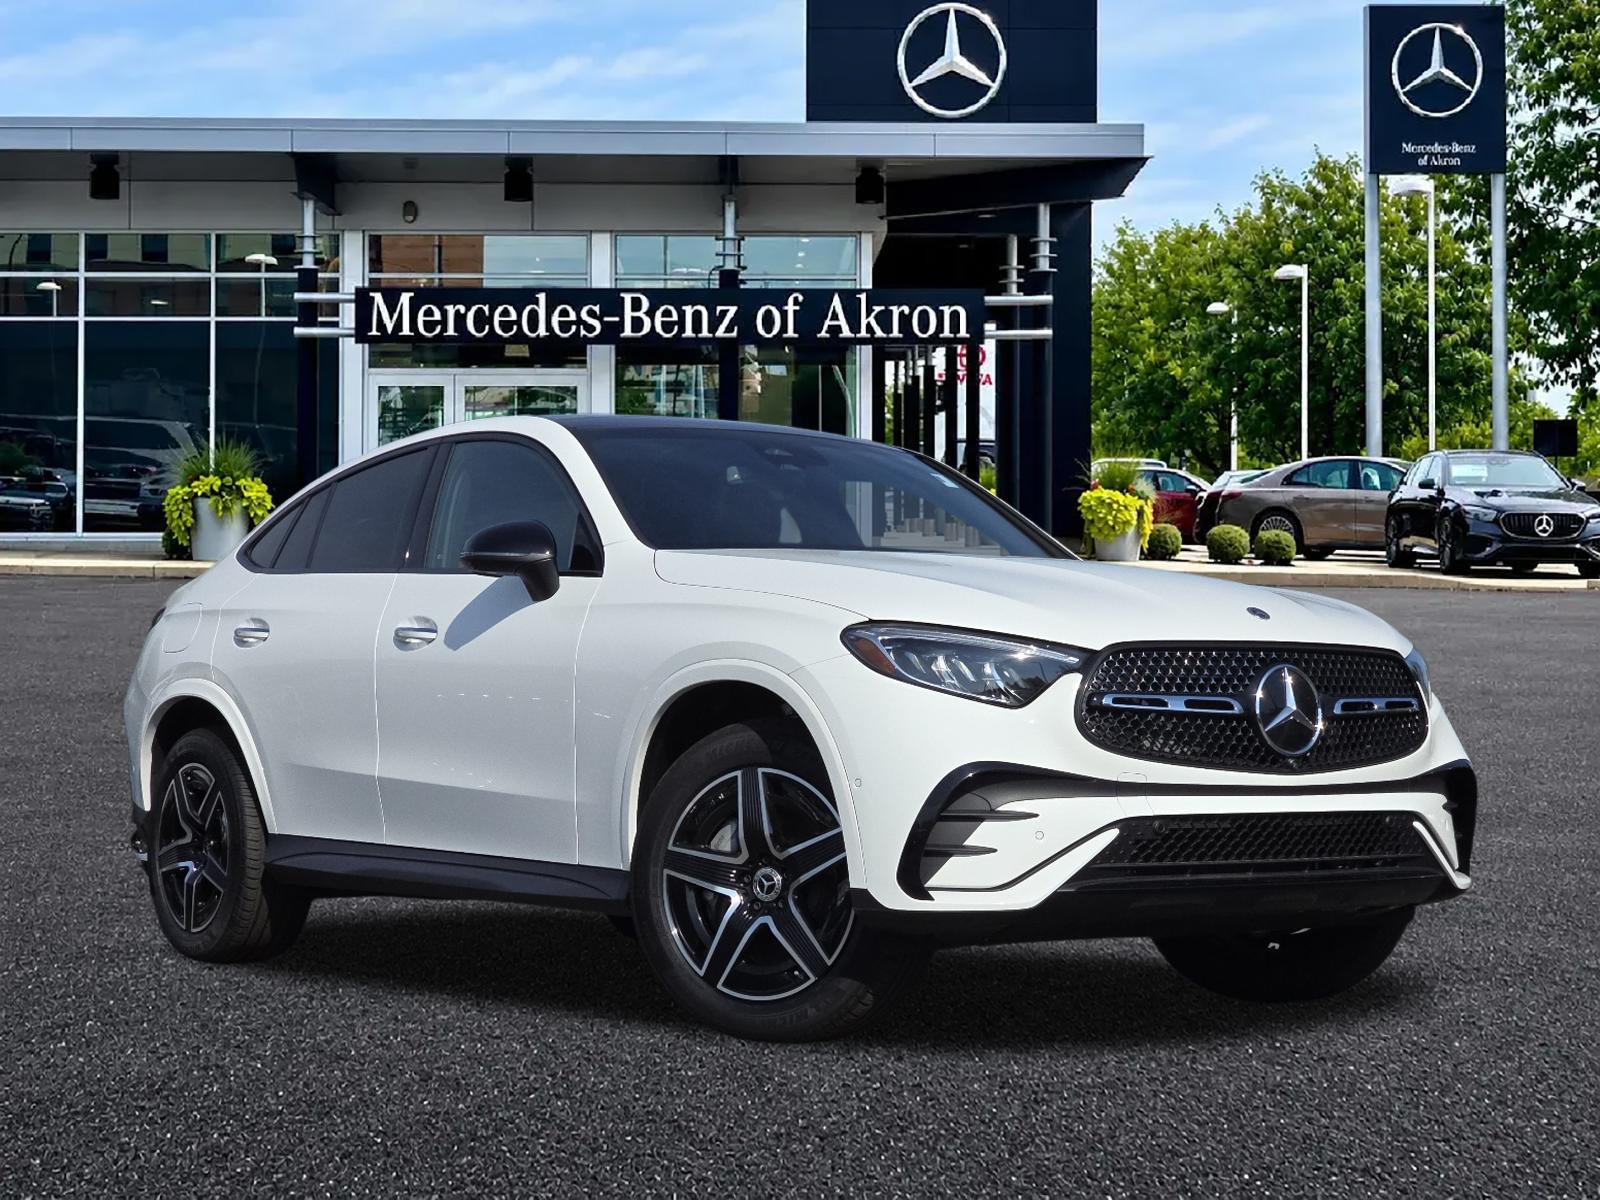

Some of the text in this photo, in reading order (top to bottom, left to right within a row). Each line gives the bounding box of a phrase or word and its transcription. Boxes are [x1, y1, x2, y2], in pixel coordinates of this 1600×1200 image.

[1401, 141, 1477, 154] Mercedes-Benz
[1417, 154, 1461, 166] of Akron
[367, 291, 971, 338] Mercedes-Benz of Akron
